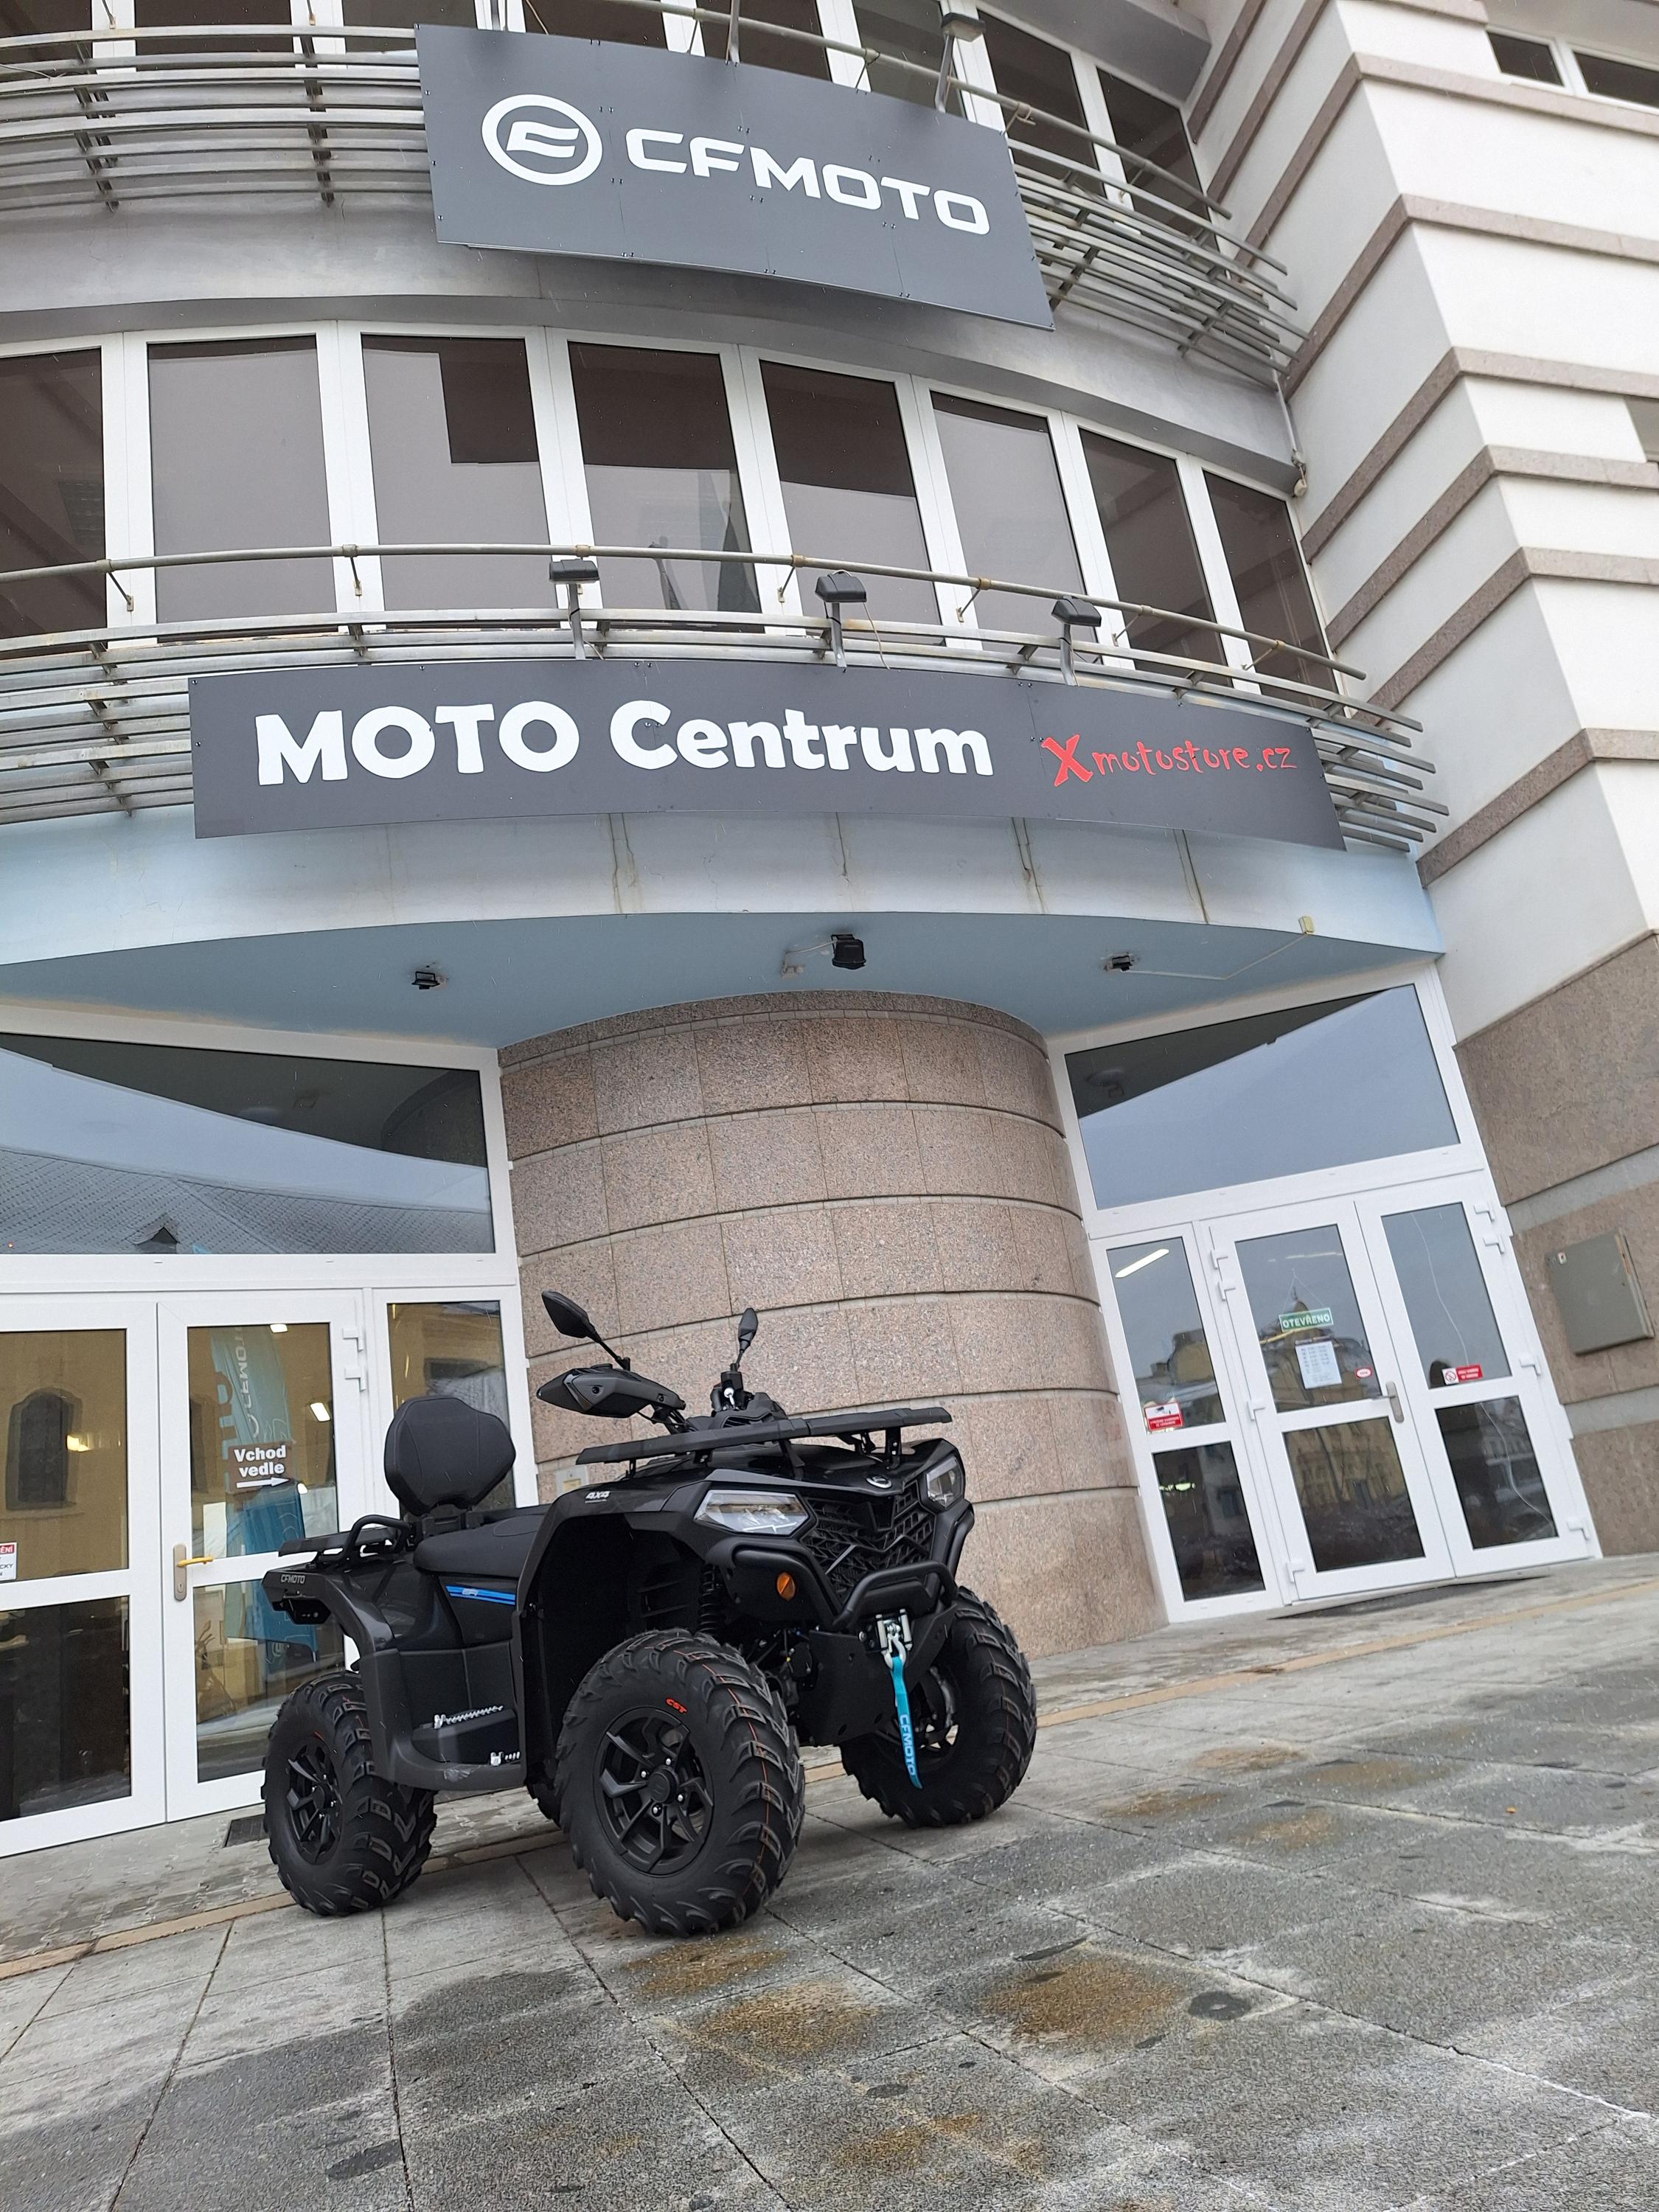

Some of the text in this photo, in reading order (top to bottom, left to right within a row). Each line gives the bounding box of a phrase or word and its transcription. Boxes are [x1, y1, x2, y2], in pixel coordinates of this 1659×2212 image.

[625, 128, 990, 235] CFMOTO
[255, 700, 580, 786] MOTO
[610, 700, 994, 776] Centrum
[234, 1445, 287, 1463] Vchod
[239, 1462, 285, 1478] vedle
[280, 1573, 306, 1585] CFMOTO
[666, 1698, 687, 1713] CST
[900, 1714, 917, 1776] CFMOTO
